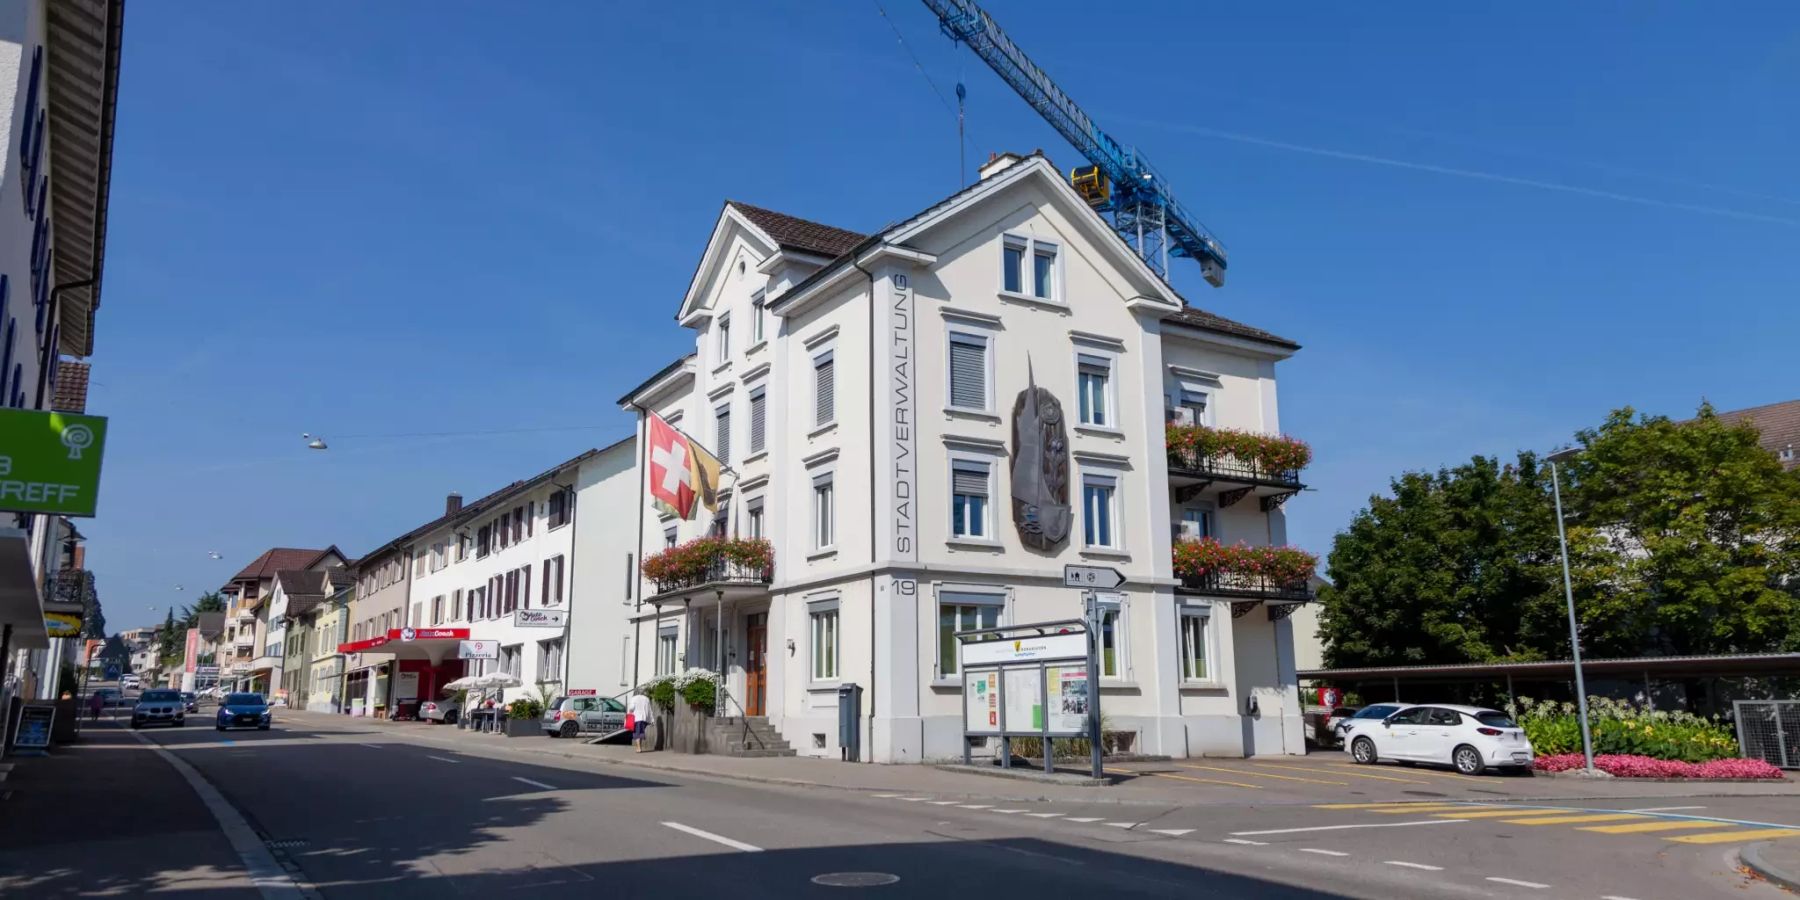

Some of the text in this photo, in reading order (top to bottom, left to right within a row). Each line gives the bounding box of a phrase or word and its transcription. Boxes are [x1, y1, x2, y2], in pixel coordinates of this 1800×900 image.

[894, 273, 911, 553] STADTVERWALTUNG
[0, 479, 80, 504] REFF
[891, 579, 916, 596] 19
